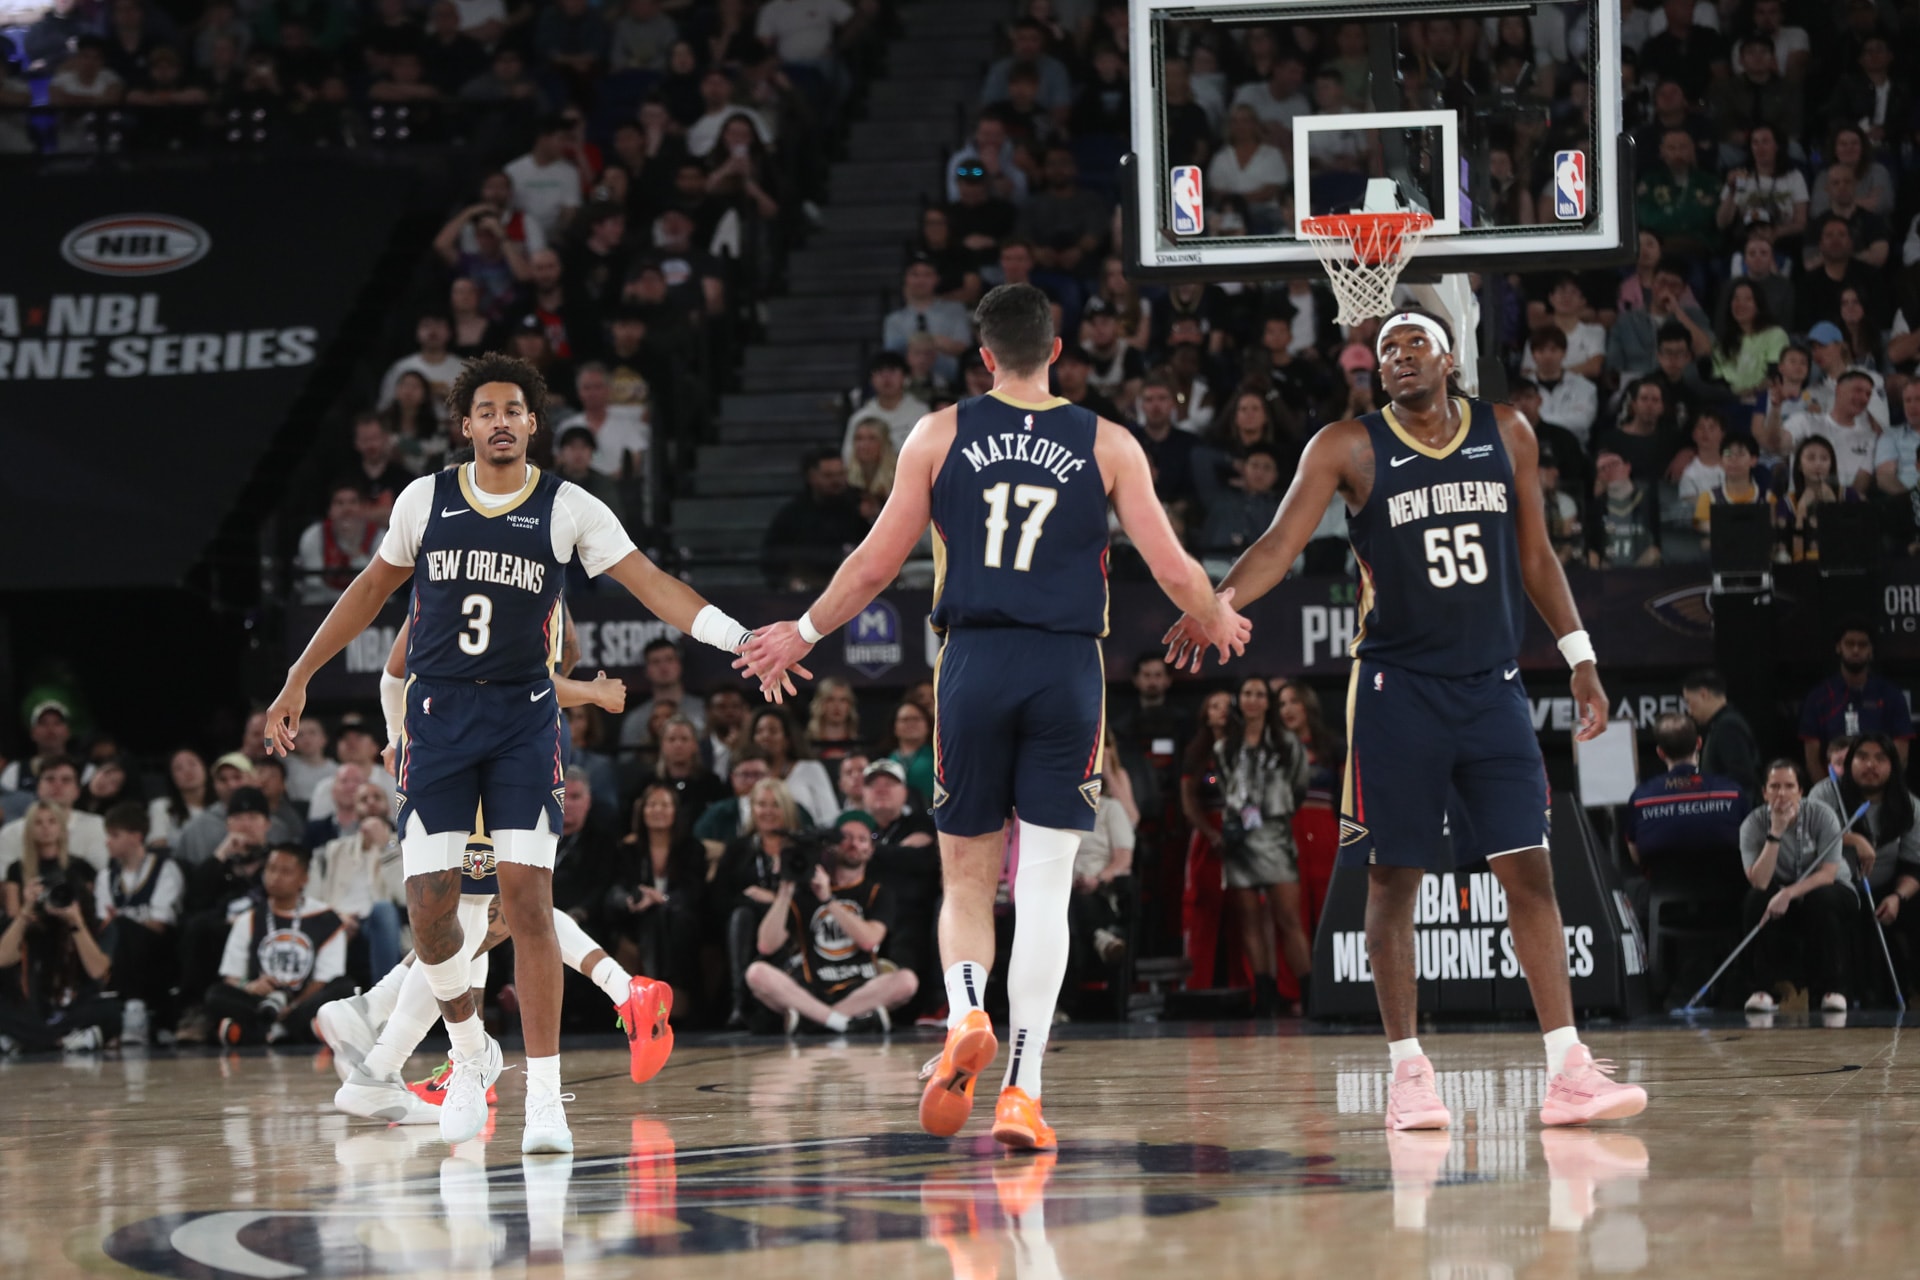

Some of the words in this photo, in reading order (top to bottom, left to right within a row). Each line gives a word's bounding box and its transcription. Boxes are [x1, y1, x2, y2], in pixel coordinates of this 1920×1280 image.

[96, 235, 169, 258] NBL
[47, 293, 167, 336] NBL
[105, 326, 319, 377] SERIES
[961, 432, 1087, 484] MATKOVIĆ
[506, 515, 540, 525] NEWAGE
[983, 481, 1058, 572] 17
[1387, 486, 1430, 528] NEW
[1431, 481, 1508, 517] ORLEANS
[426, 549, 463, 582] NEW
[466, 549, 545, 595] ORLEANS
[1423, 522, 1488, 588] 55
[458, 594, 493, 655] 3
[1642, 803, 1675, 821] EVENT
[1677, 799, 1733, 816] SECURITY
[1470, 872, 1508, 923] NB
[1333, 927, 1496, 983] MEURNE
